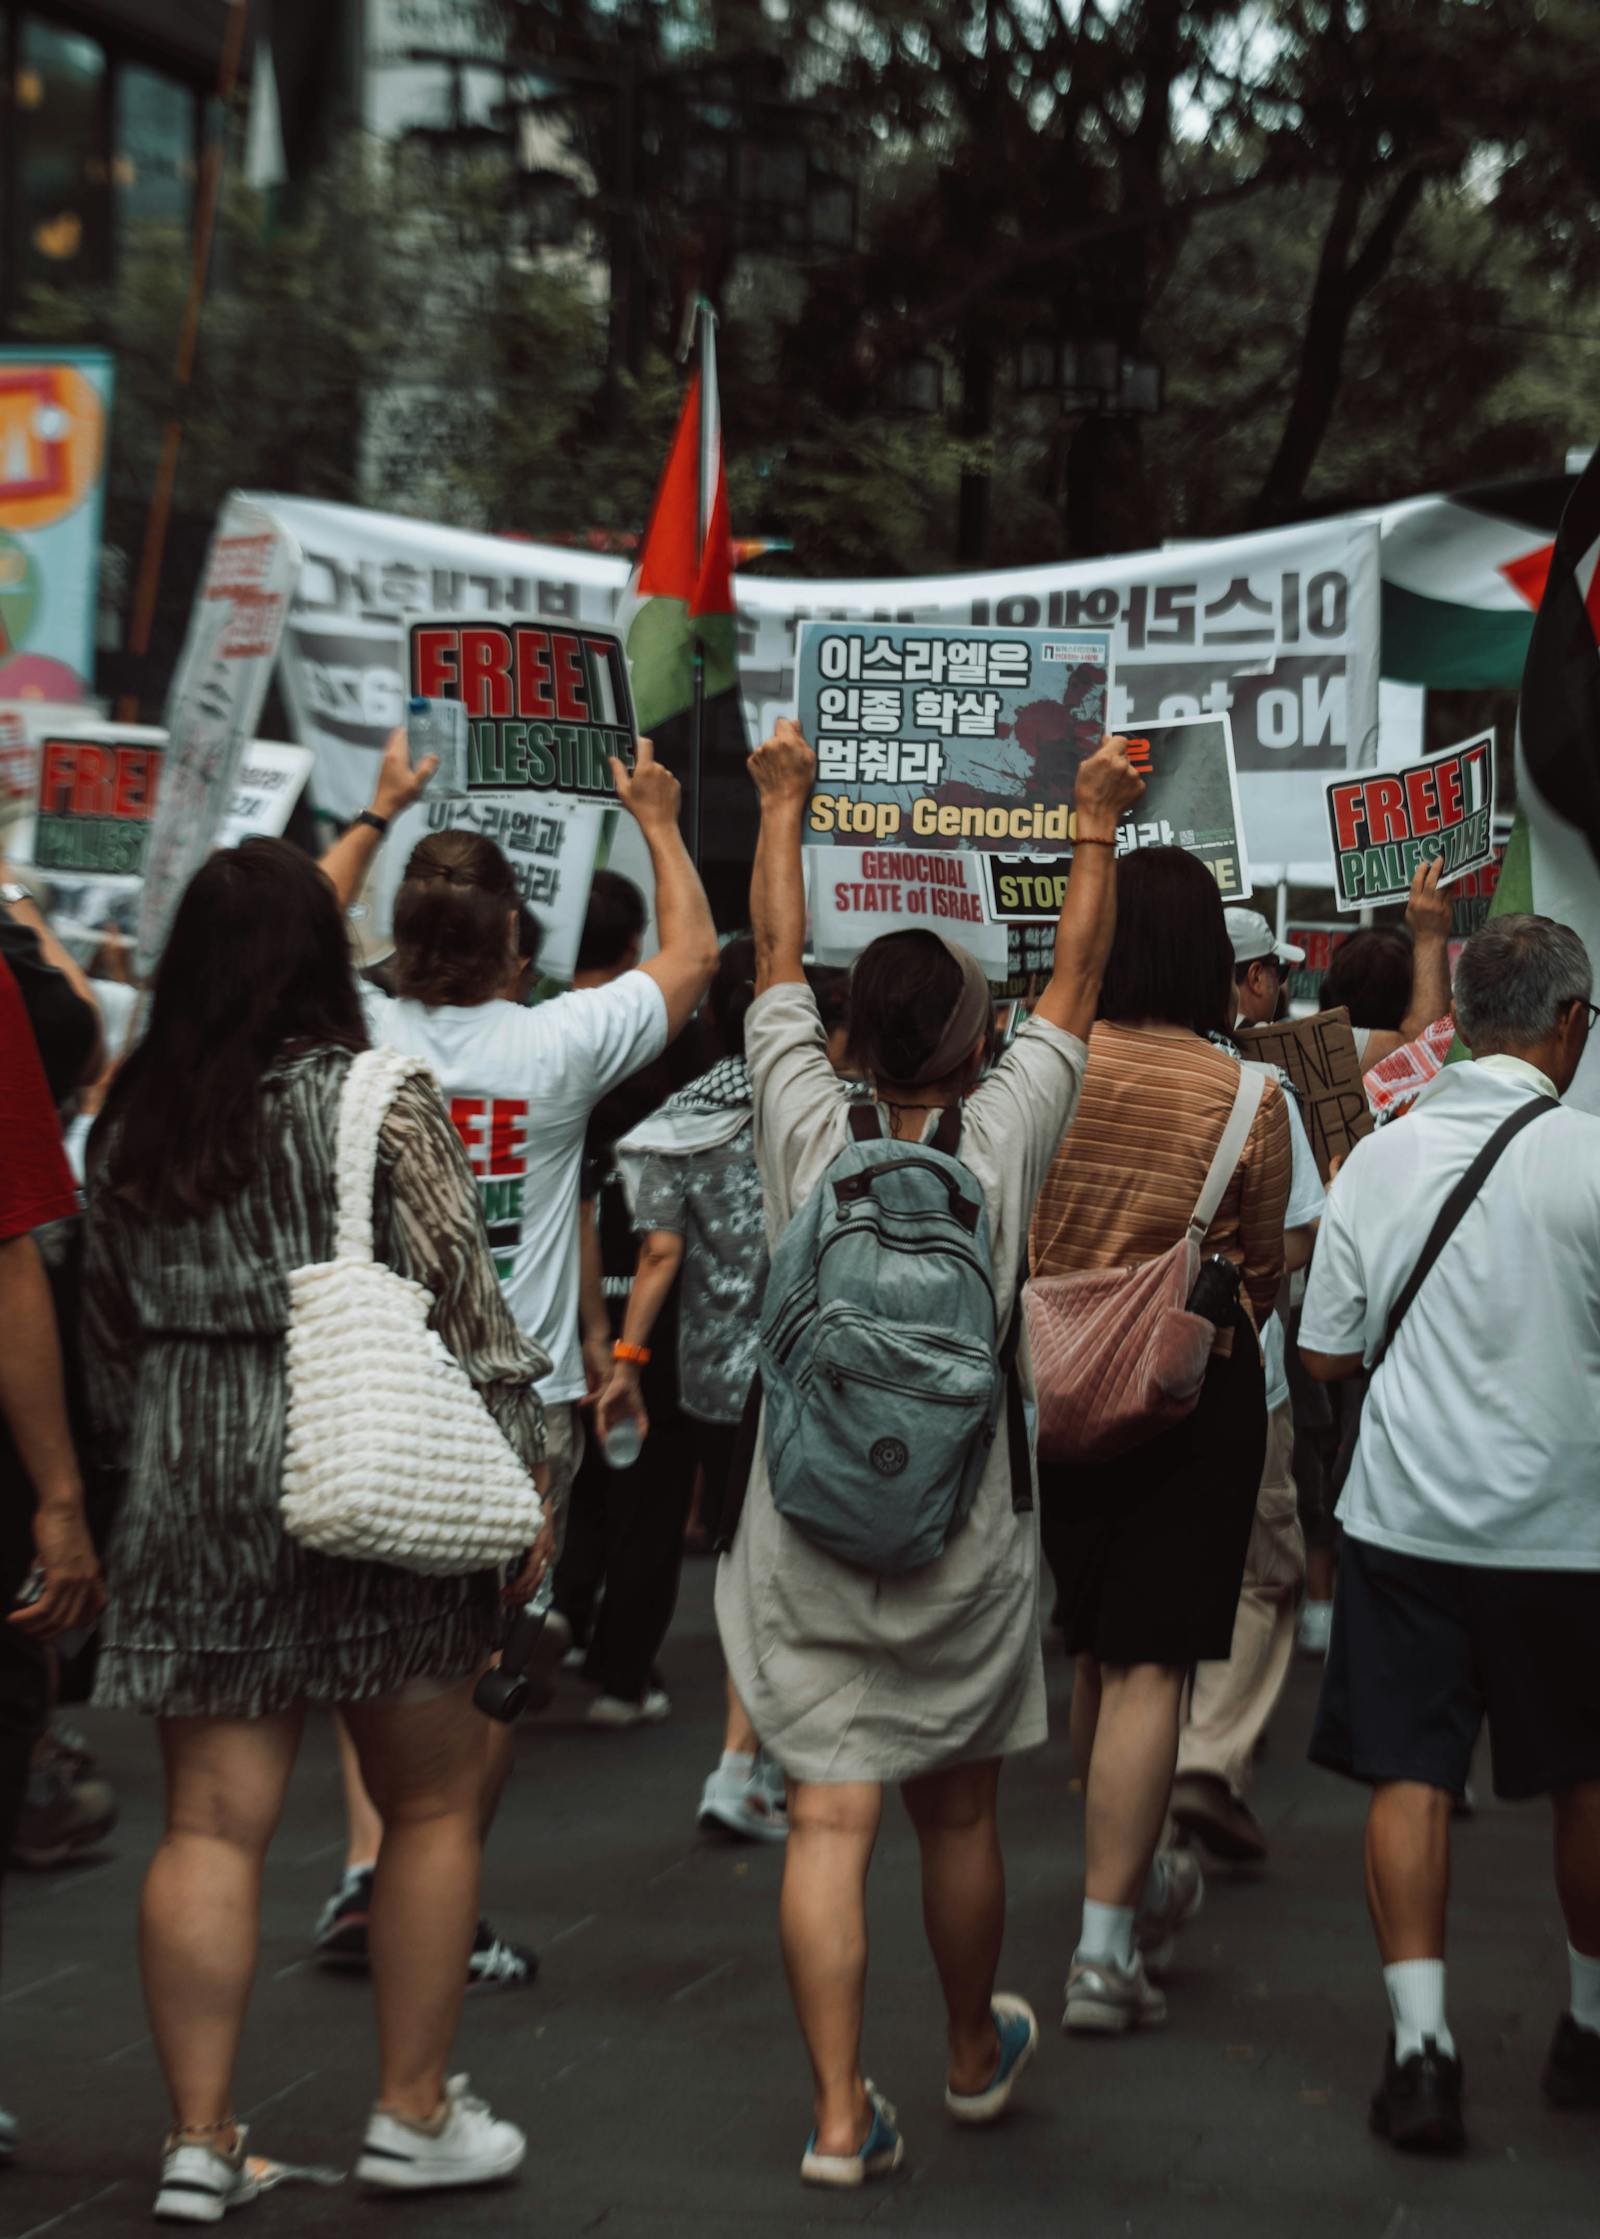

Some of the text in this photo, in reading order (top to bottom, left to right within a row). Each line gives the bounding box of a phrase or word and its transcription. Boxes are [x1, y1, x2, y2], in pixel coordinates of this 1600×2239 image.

[417, 629, 589, 722] FREE
[818, 636, 1031, 688] 이스라엘은
[817, 687, 902, 734] 인종
[913, 689, 1001, 737] 학살
[817, 738, 945, 786] 멈춰라
[809, 794, 901, 839] Stop
[1331, 758, 1465, 852] FREE
[861, 851, 967, 889] GENOCIDAL
[1340, 808, 1488, 898] PALESTINE
[835, 882, 984, 923] STATE of ISRAE
[999, 875, 1068, 909] STOP
